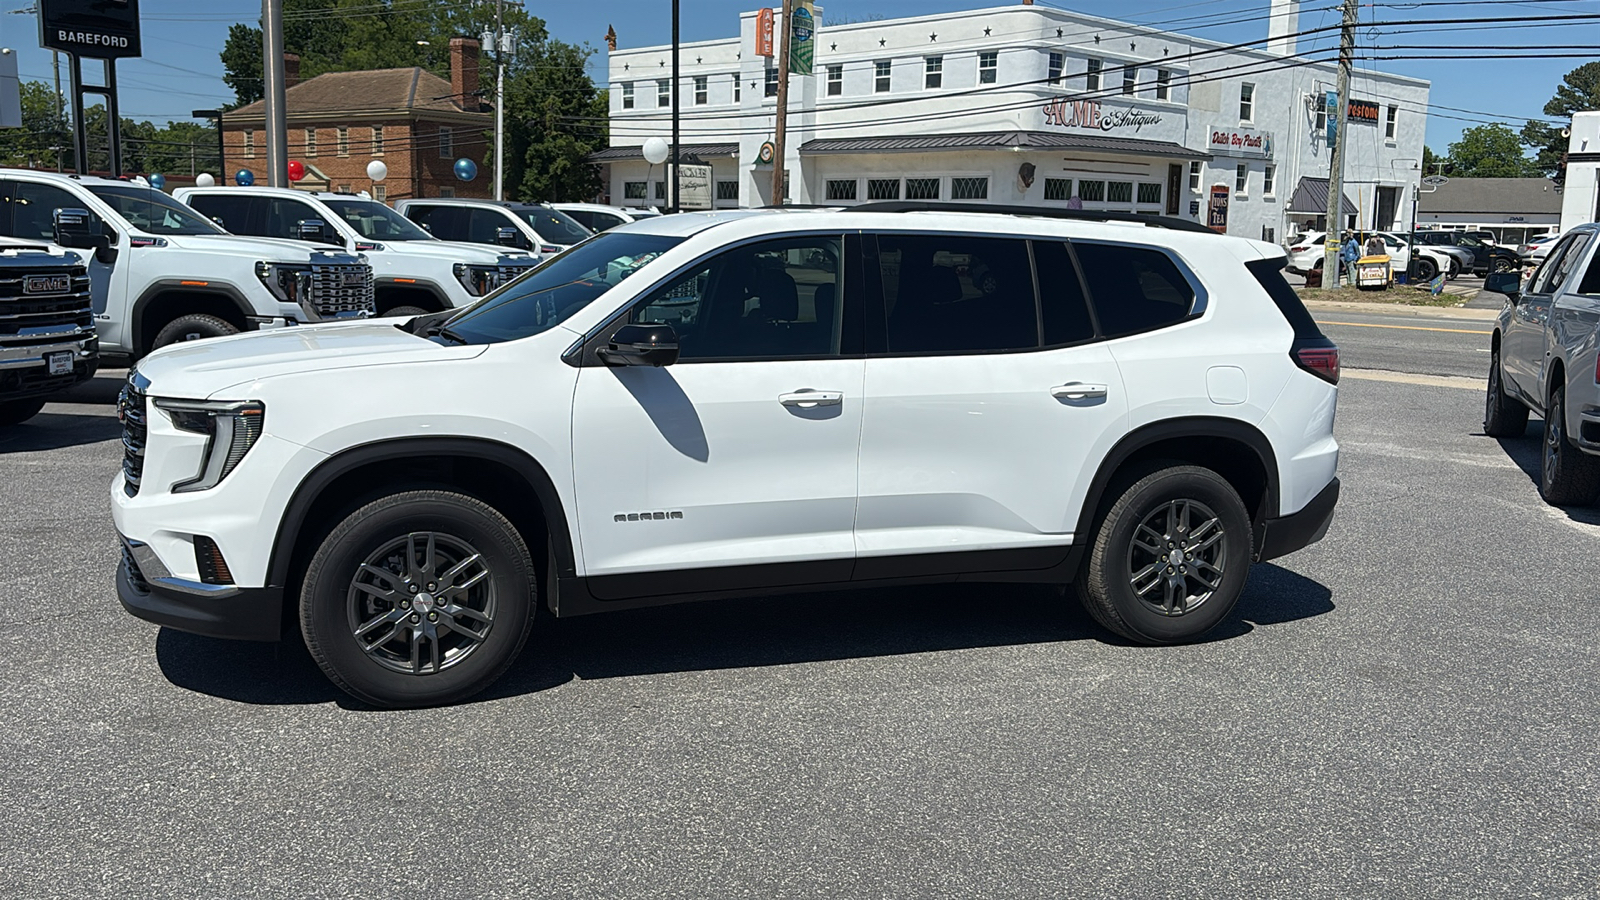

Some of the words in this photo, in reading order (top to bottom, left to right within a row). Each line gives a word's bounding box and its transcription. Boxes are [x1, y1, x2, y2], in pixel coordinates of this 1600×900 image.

[58, 30, 128, 48] BAREFORD
[764, 11, 772, 53] ACME
[1043, 95, 1101, 129] ACME
[1113, 104, 1162, 133] Antiques
[1347, 103, 1378, 120] restone
[1212, 131, 1229, 145] Dutch
[1231, 133, 1243, 149] Boy
[1243, 134, 1262, 148] Paints
[1212, 212, 1225, 224] TEA
[29, 277, 69, 291] GMC
[613, 511, 683, 522] ACADIA
